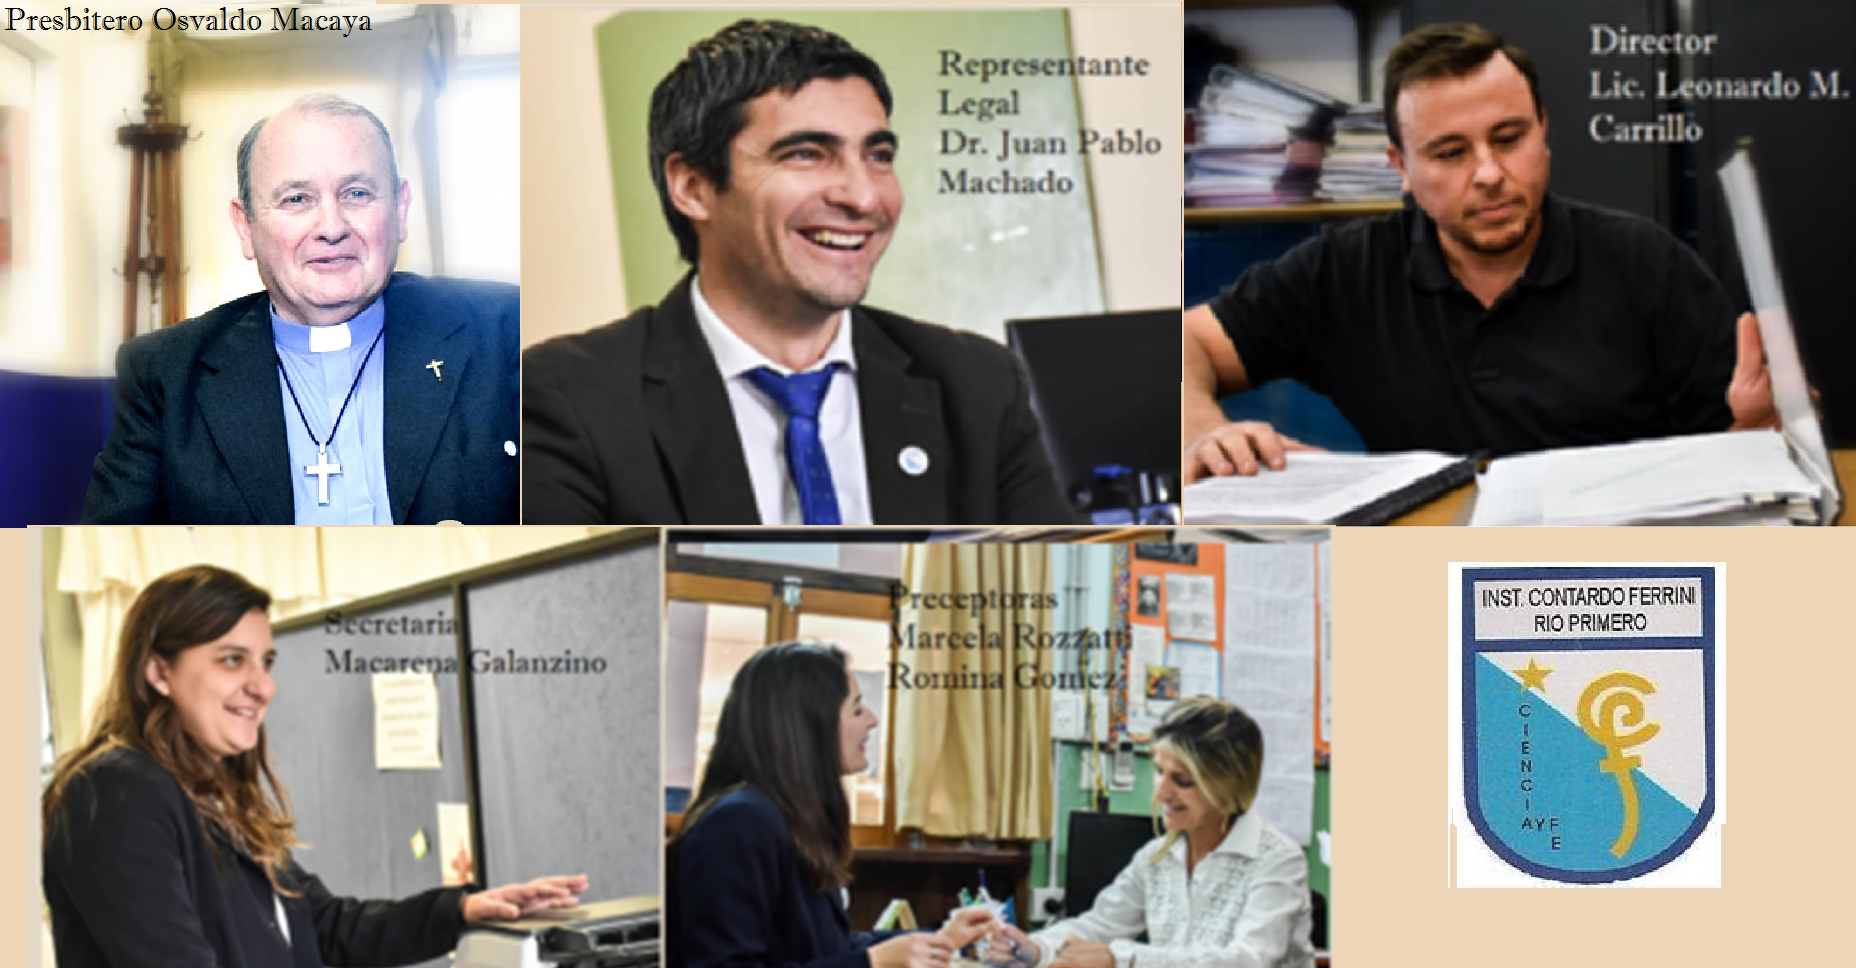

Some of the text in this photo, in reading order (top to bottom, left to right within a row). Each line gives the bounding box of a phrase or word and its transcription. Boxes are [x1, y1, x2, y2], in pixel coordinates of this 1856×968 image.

[1482, 586, 1696, 608] INST. CONTARDO FERRINI
[1534, 613, 1647, 632] RIO PRIMERO
